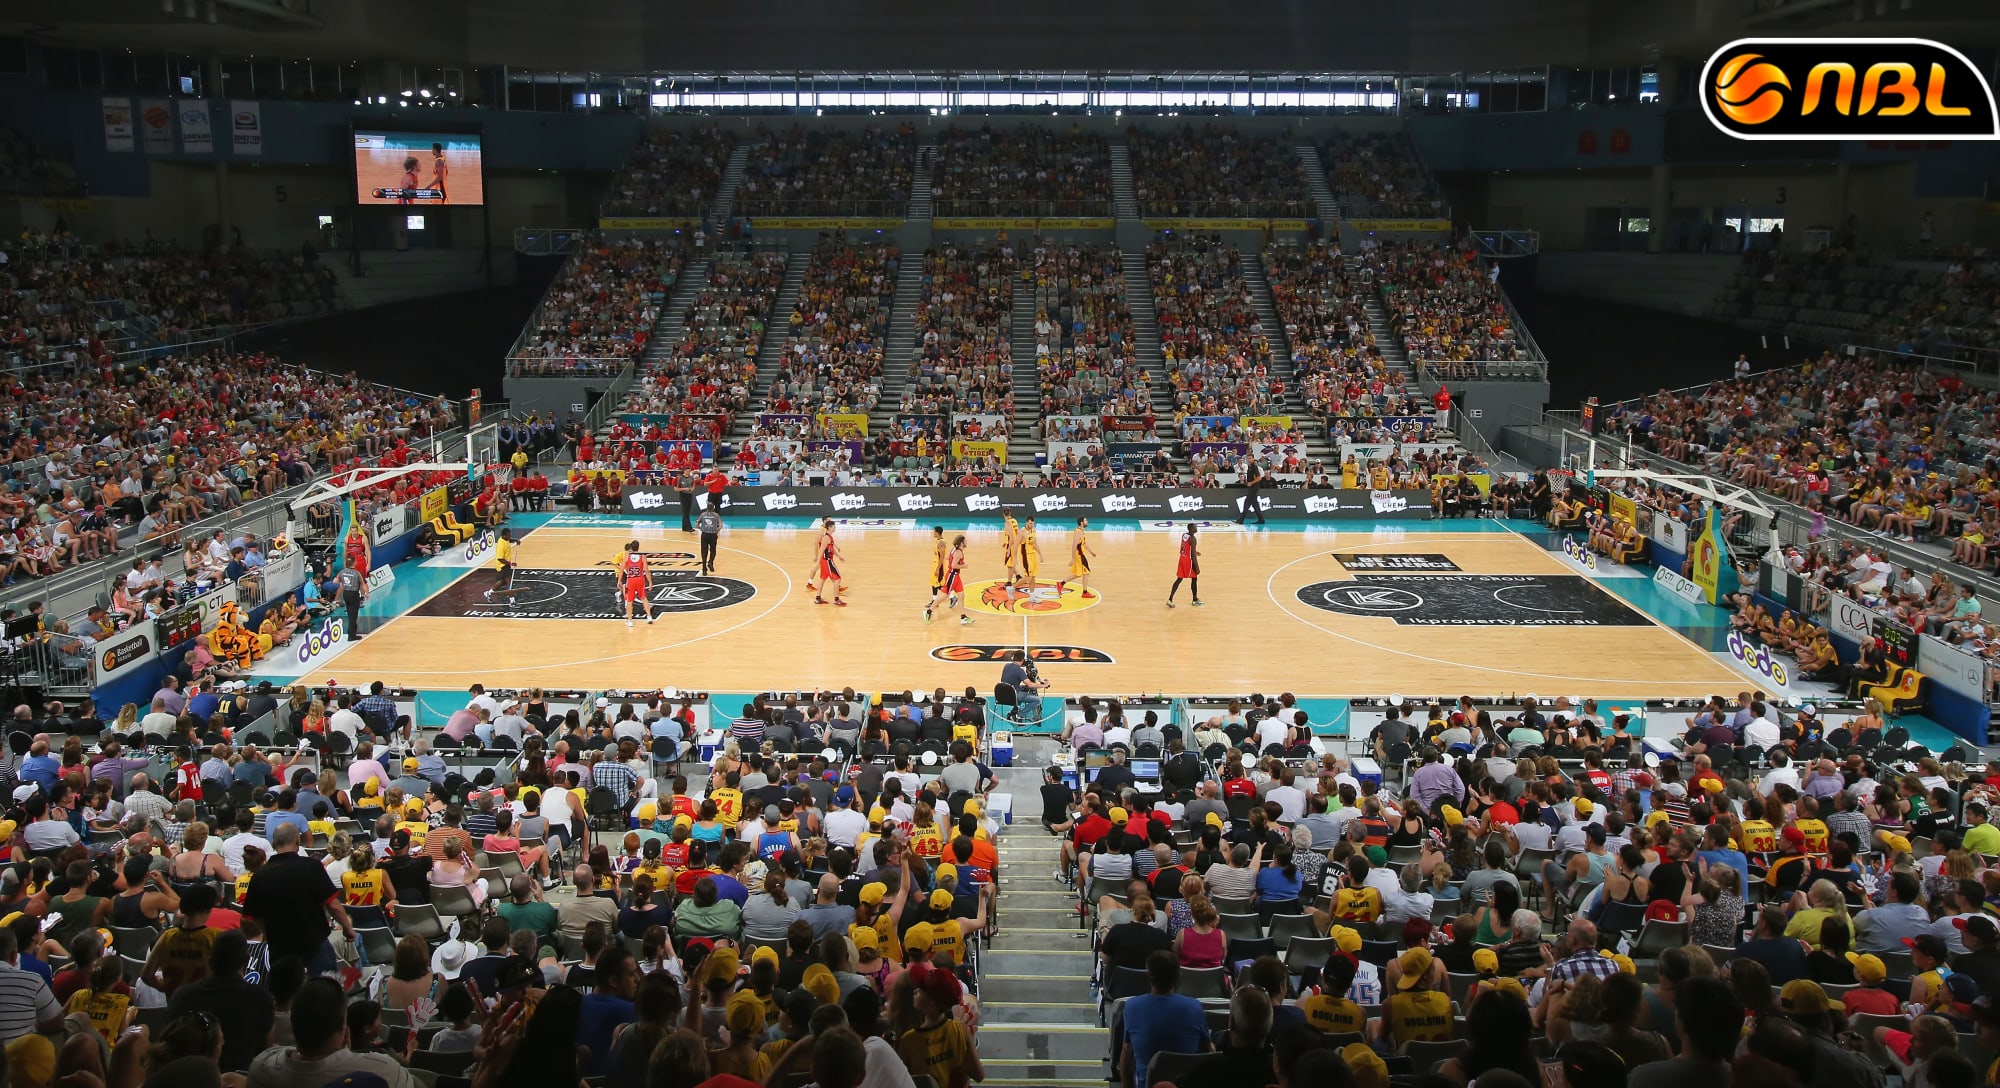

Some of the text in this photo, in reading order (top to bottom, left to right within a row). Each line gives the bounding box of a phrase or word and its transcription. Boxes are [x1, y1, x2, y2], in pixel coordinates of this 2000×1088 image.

[465, 529, 496, 561] dodo
[1562, 534, 1596, 570] dodo
[629, 566, 641, 577] 53
[1664, 572, 1674, 582] CTI
[1684, 583, 1695, 593] CTI
[209, 593, 224, 610] CTI
[1409, 618, 1599, 626] lkproperty.com.au
[1840, 604, 1870, 636] CCA
[117, 638, 144, 657] Basketball
[299, 617, 343, 663] dodo
[1728, 631, 1788, 686] dodo
[218, 700, 231, 714] 11
[191, 773, 201, 789] 14
[765, 844, 787, 854] DURANT
[915, 838, 939, 856] 43
[1753, 837, 1775, 852] 33
[1805, 838, 1827, 853] 54
[1322, 875, 1338, 895] 8
[349, 892, 375, 905] 24
[1312, 1009, 1353, 1025] GOULDING
[1404, 1015, 1446, 1027] GOULDING
